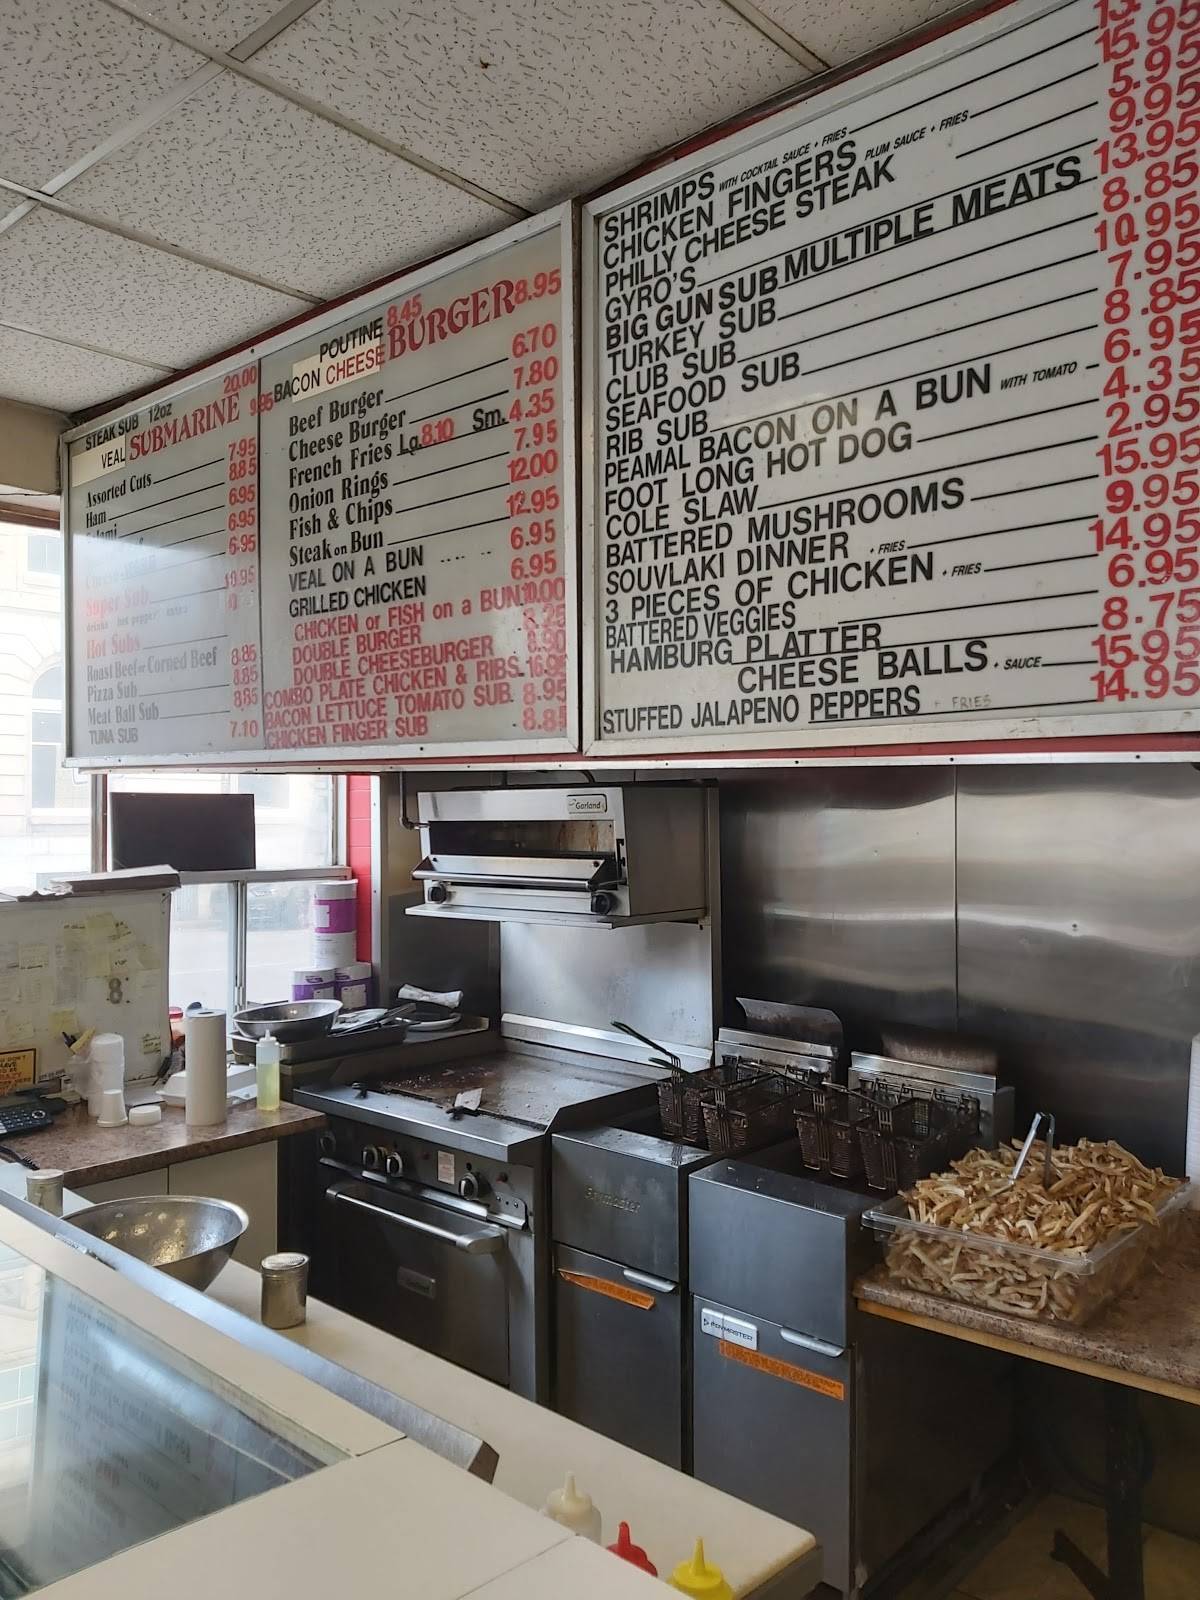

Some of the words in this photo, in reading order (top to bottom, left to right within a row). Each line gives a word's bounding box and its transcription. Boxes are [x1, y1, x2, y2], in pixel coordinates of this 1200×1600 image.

[603, 201, 713, 270] CHICKEN
[728, 140, 857, 218] FINGERS
[864, 141, 890, 161] PLUM
[893, 127, 926, 149] SAUCE
[939, 110, 969, 132] FRIES
[604, 171, 715, 243] SHRIMPS
[719, 175, 739, 192] WITH
[740, 157, 779, 183] COCKTAIL
[782, 143, 811, 164] SAUCE
[822, 127, 848, 146] FRIES
[606, 246, 677, 297] PHILLY
[684, 200, 786, 263] CHEESE
[796, 154, 895, 218] STEAK
[606, 314, 648, 351] BIG
[655, 288, 713, 332] GUN
[719, 266, 778, 310] SUB
[784, 202, 934, 283] MULTIPLE
[952, 155, 1081, 227] MEATS
[605, 266, 696, 323] GYRO'S
[607, 321, 704, 376] TURKEY
[719, 297, 776, 340] SUB
[1103, 149, 1199, 212] 8.85
[274, 368, 321, 403] BACON
[326, 344, 386, 385] CHEESE
[387, 279, 516, 361] BURGER
[513, 269, 562, 305] 8.95
[320, 317, 383, 363] POUTINE
[387, 293, 422, 328] 8.45
[223, 366, 257, 393] 20.00
[289, 405, 323, 437] Beef
[329, 389, 384, 423] Burger
[512, 323, 557, 359] 6.70
[605, 374, 726, 432] SEAFOOD
[741, 351, 800, 393] SUB
[606, 363, 668, 404] CLUB
[682, 340, 737, 380] SUB
[85, 425, 116, 450] STEAK
[118, 415, 139, 437] SUB
[101, 448, 126, 469] VEAL
[130, 393, 240, 461] SUBMARINE
[289, 431, 343, 462] Cheese
[349, 409, 406, 444] Burger
[513, 356, 559, 390] 7.80
[289, 455, 342, 488] French
[350, 443, 392, 471] Fries
[421, 417, 455, 446] 8.10
[508, 388, 555, 422] 4.35
[605, 443, 691, 488] PEAMAL
[699, 414, 796, 464] BACON
[811, 398, 858, 435] ON
[875, 389, 897, 421] A
[916, 363, 991, 411] BUN
[1000, 374, 1027, 391] WITH
[1032, 361, 1078, 382] TOMATO
[606, 428, 643, 460] RIB
[656, 409, 708, 446] SUB
[86, 480, 126, 508] Assorted
[130, 473, 152, 493] Cuts
[228, 437, 256, 461] 7.95
[86, 512, 107, 529] Ham
[229, 457, 256, 481] 8.85
[228, 484, 255, 506] 6.95
[289, 487, 334, 514] Onion
[341, 470, 388, 501] Rings
[513, 419, 558, 451] 7.95
[289, 513, 321, 540] Fish
[327, 508, 339, 530] &
[345, 498, 393, 525] Chips
[507, 449, 558, 483] 12.00
[605, 478, 668, 516] FOOT
[682, 456, 754, 498] LONG
[767, 437, 827, 478] HOT
[838, 421, 912, 465] DOG
[606, 504, 670, 540] COLE
[684, 484, 759, 525] SLAW
[1106, 386, 1200, 438] 2.95
[228, 508, 255, 531] 6.95
[229, 535, 255, 555] 6.95
[289, 538, 332, 567] Steak
[334, 545, 348, 556] on
[351, 530, 384, 554] Bun
[506, 485, 560, 517] 12.95
[606, 522, 733, 568] BATTERED
[748, 477, 965, 544] MUSHROOMS
[606, 552, 725, 595] SOUVLAKI
[737, 531, 849, 576] DINNER
[878, 540, 906, 554] FRIES
[1106, 470, 1200, 514] 9.95
[289, 568, 326, 592] VEAL
[332, 560, 355, 583] ON
[363, 556, 376, 577] A
[385, 545, 424, 573] BUN
[510, 519, 556, 550] 6.95
[289, 591, 349, 618] GRILLED
[354, 575, 427, 608] CHICKEN
[511, 550, 557, 580] 6.95
[605, 599, 619, 624] 3
[631, 584, 720, 621] PIECES
[735, 576, 773, 607] OF
[788, 552, 934, 600] CHICKEN
[951, 562, 982, 577] FRIES
[295, 613, 359, 642] CHICKEN
[365, 615, 381, 631] or
[388, 601, 425, 628] FISH
[432, 601, 453, 620] on
[461, 598, 472, 615] a
[480, 584, 521, 613] BUN
[521, 577, 566, 605] 10.00
[606, 614, 699, 650] BATTERED
[704, 600, 797, 639] VEGGIES
[1108, 546, 1200, 588] 6.95
[87, 664, 113, 682] Roast
[115, 659, 138, 679] Beef
[147, 651, 187, 673] Corned
[191, 646, 217, 669] Beef
[231, 644, 256, 666] 8.85
[292, 637, 350, 666] DOUBLE
[356, 624, 422, 655] BURGER
[293, 659, 351, 686] DOUBLE
[358, 634, 494, 677] CHEESEBURGER
[610, 638, 733, 674] HAMBURG
[746, 622, 882, 663] PLATTER
[738, 655, 859, 694] CHEESE
[878, 639, 989, 681] BALLS
[1003, 656, 1042, 670] SAUCE
[1091, 626, 1200, 669] 15.95
[87, 685, 114, 703] Pizza
[117, 681, 138, 699] Sub
[88, 707, 111, 725] Meat
[115, 703, 135, 724] Ball
[139, 702, 159, 720] Sub
[264, 686, 313, 710] COMBO
[319, 678, 366, 702] PLATE
[373, 665, 447, 696] CHICKEN
[455, 663, 467, 685] &
[264, 706, 311, 730] BACON
[317, 697, 388, 723] LETTUCE
[395, 688, 465, 715] TOMATO
[522, 678, 567, 706] 8.95
[603, 704, 683, 734] STUFFED
[691, 694, 800, 729] JALAPENO
[810, 685, 920, 720] PEPPERS
[1090, 660, 1200, 703] 14.95
[89, 729, 114, 745] TUNA
[117, 727, 138, 744] SUB
[230, 719, 259, 739] 7.10
[265, 725, 326, 749] CHICKEN
[332, 719, 388, 744] FINGER
[395, 715, 428, 738] SUB
[575, 801, 601, 810] Garland
